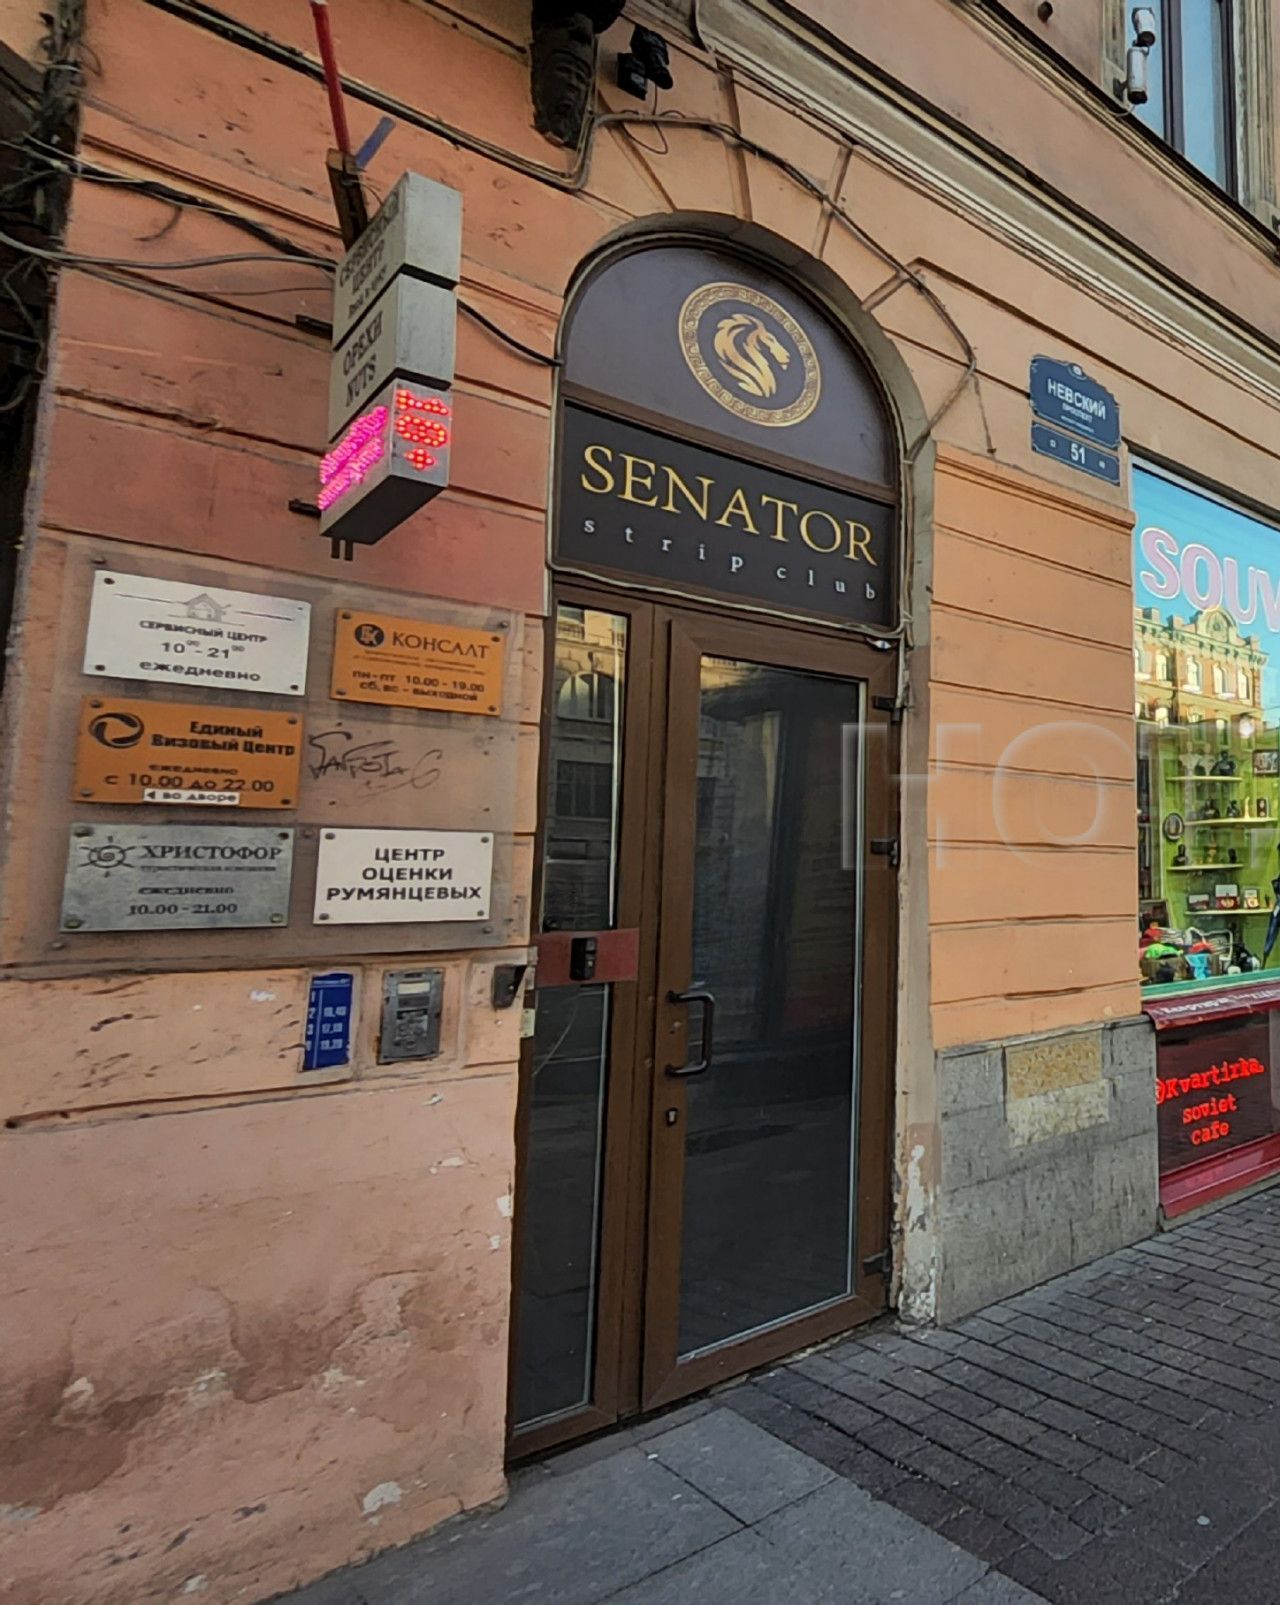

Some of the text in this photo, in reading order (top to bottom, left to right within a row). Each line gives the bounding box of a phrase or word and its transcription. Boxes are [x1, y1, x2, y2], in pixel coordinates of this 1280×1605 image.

[343, 310, 383, 377] ОРЕХИ
[346, 352, 377, 407] NUTS
[1047, 378, 1106, 420] НЕВСКИЙ
[1070, 443, 1086, 464] 51
[580, 445, 878, 566] SENATOR
[583, 516, 877, 601] strip club
[139, 620, 268, 643] СЕРВИСНЫЙ ЦЕНТР
[392, 631, 490, 659] КОНСАЛТ
[139, 660, 261, 682] ежедневно
[405, 675, 440, 687] 10.00
[452, 680, 485, 692] 19.00
[412, 687, 478, 701] выходной
[189, 720, 263, 738] Единый
[151, 733, 296, 756] Визовый Центр
[128, 773, 184, 787] 10.00
[189, 780, 218, 790] до
[223, 778, 275, 792] 22.00
[140, 844, 283, 861] ХРИСТОФОР
[374, 847, 446, 864] ЦЕНТР
[362, 867, 453, 884] ОЦЕНКИ
[138, 886, 235, 895] ежедневно
[326, 886, 483, 902] РУМЯНЦЕВЫХ
[128, 903, 178, 916] 10.00
[191, 903, 238, 915] 21.00
[1182, 1093, 1238, 1125] soviet
[1191, 1120, 1231, 1146] cafe
